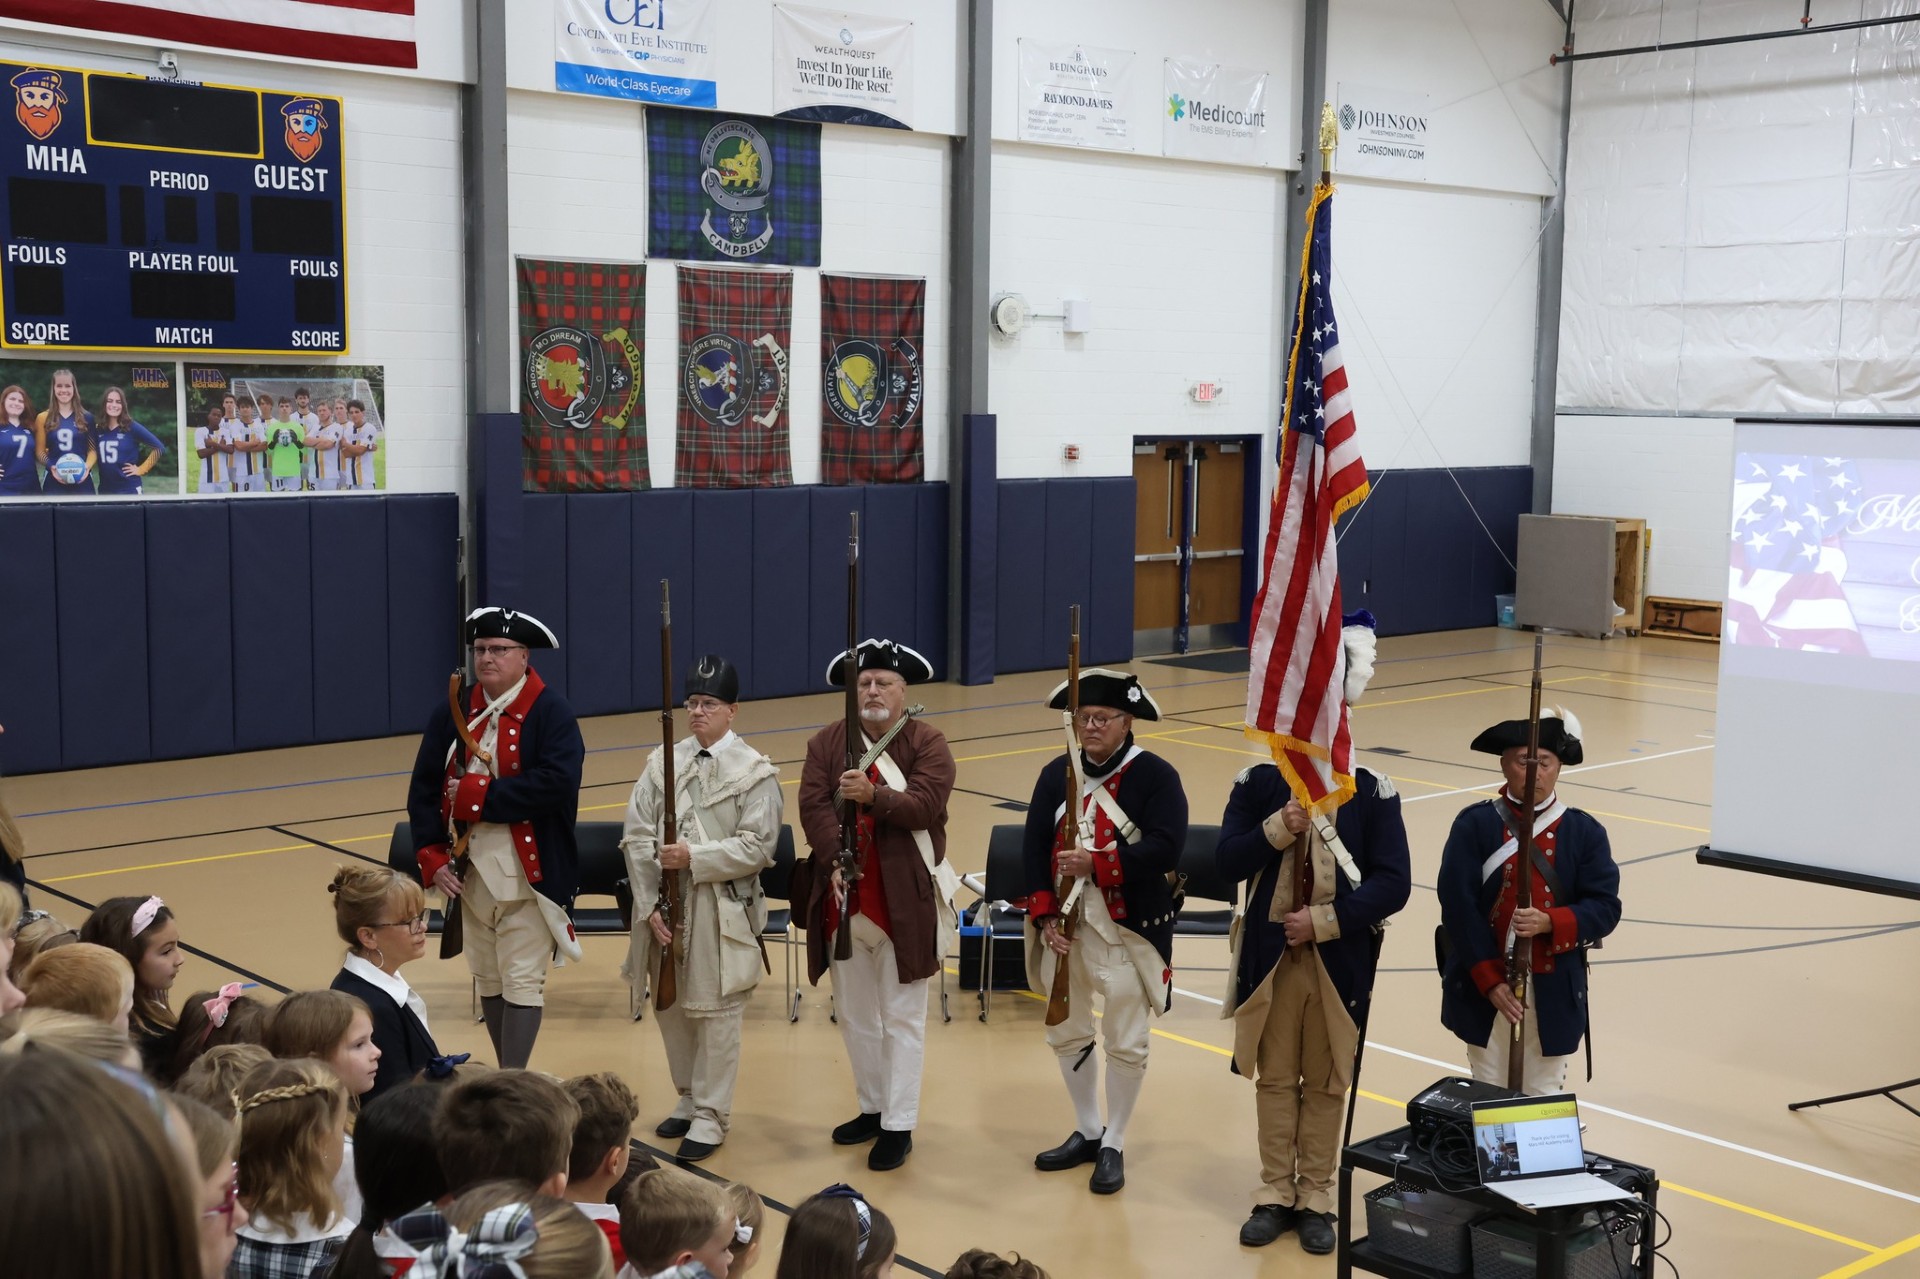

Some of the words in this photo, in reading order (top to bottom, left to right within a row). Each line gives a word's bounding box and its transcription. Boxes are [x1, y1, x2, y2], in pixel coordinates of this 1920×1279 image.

[604, 0, 664, 30] CEI
[567, 22, 627, 44] CINCINATI
[651, 54, 685, 64] PHYSICIANS
[814, 45, 876, 60] WEALTHQUEST
[797, 58, 828, 73] Invest
[831, 62, 842, 74] In
[845, 63, 869, 78] Your
[872, 66, 893, 80] Life.
[1049, 62, 1107, 77] BEDINGHAUS
[149, 75, 200, 86] DAKTRONICS
[585, 73, 649, 91] World-Class
[650, 81, 691, 96] Eyecare
[800, 72, 824, 86] We'll
[827, 75, 842, 88] Do
[844, 77, 864, 90] The
[1043, 93, 1084, 107] RAYMOND
[1086, 98, 1113, 110] JAMES
[1189, 100, 1265, 127] Medicount
[1358, 110, 1427, 132] JOHNSON
[1190, 124, 1200, 132] The
[1201, 125, 1213, 134] EMS
[1215, 127, 1231, 137] Billing
[1232, 128, 1253, 137] Experts
[26, 144, 87, 174] MHA
[1358, 144, 1424, 160] JOHNSONINV.COM
[150, 170, 209, 191] PERIOD
[254, 164, 328, 192] GUEST
[709, 233, 767, 255] CAMPBELL
[8, 245, 67, 265] FOULS
[129, 251, 193, 271] PLAYER
[198, 254, 239, 273] FOUL
[290, 259, 339, 278] FOULS
[11, 322, 70, 341] SCORE
[155, 327, 213, 344] MATCH
[291, 331, 340, 347] SCORE
[535, 338, 549, 350] MO
[550, 332, 582, 344] DHREAM
[710, 338, 732, 350] VIRTUS
[132, 368, 167, 382] MHA
[191, 369, 226, 383] MHA
[905, 351, 919, 413] WALLACE
[827, 371, 844, 412] LIBERTATE
[12, 435, 27, 458] 7
[57, 429, 73, 451] 9
[99, 440, 119, 463] 15
